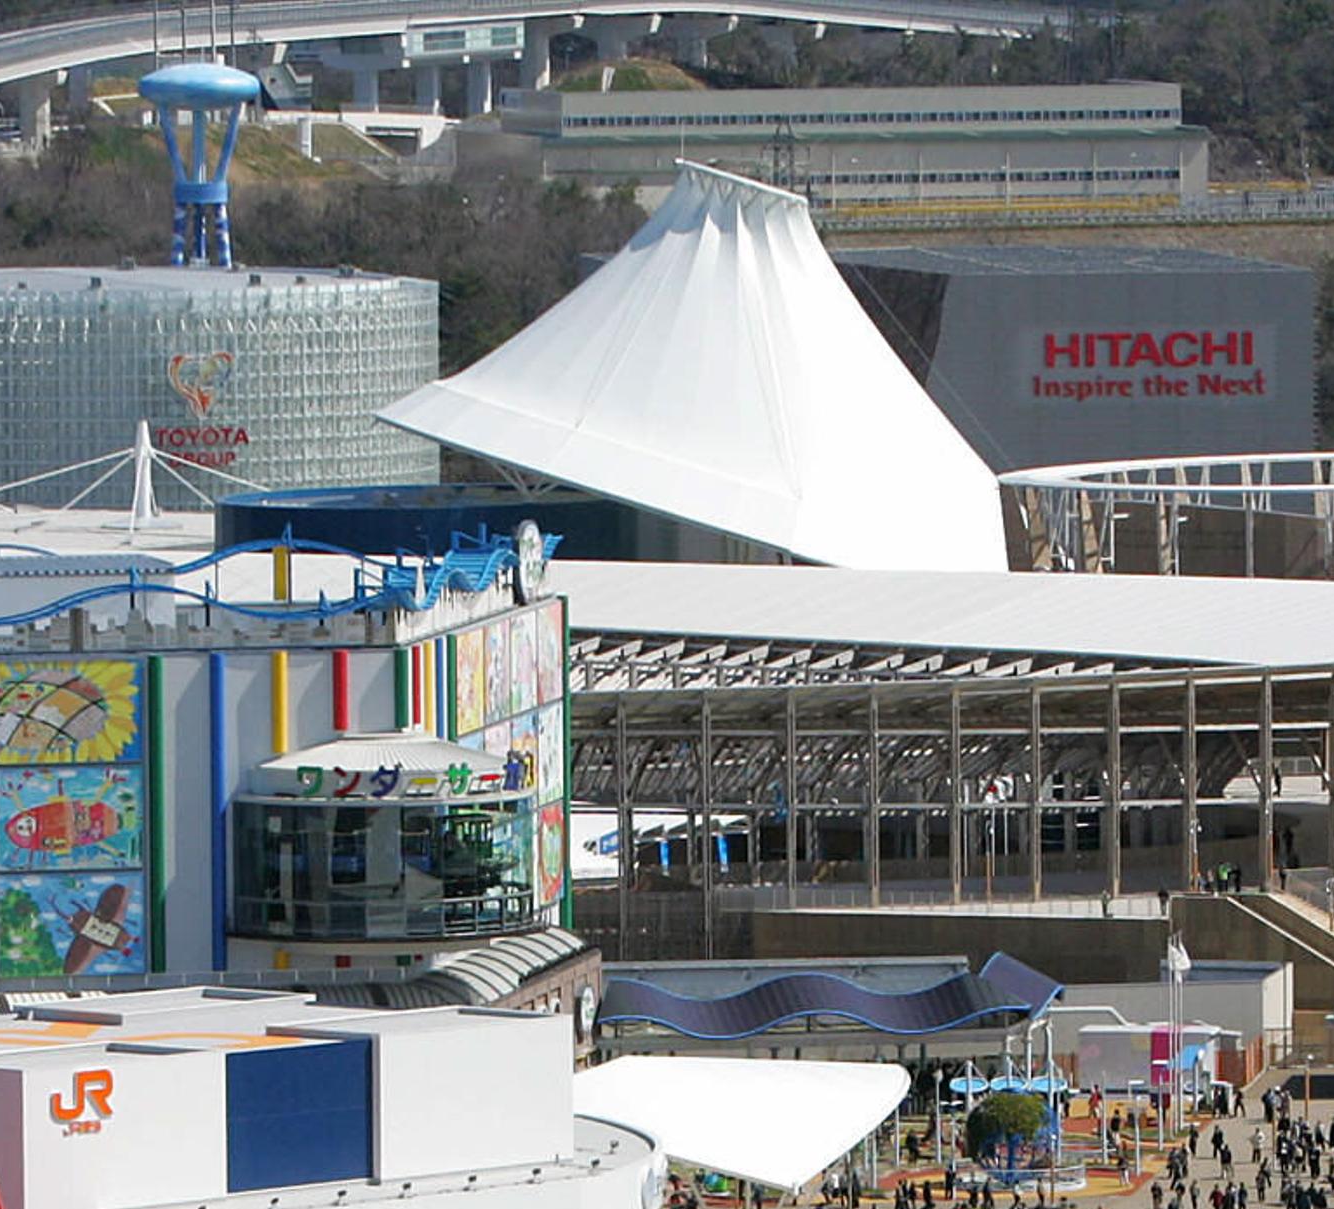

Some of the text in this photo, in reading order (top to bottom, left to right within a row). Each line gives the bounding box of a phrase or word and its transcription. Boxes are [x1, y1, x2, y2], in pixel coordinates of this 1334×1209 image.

[1043, 331, 1254, 369] HITACHI
[1032, 368, 1265, 401] Inspire the Next
[155, 426, 250, 447] TOYOTA
[168, 451, 236, 468] GROUP
[49, 1069, 114, 1125] JR
